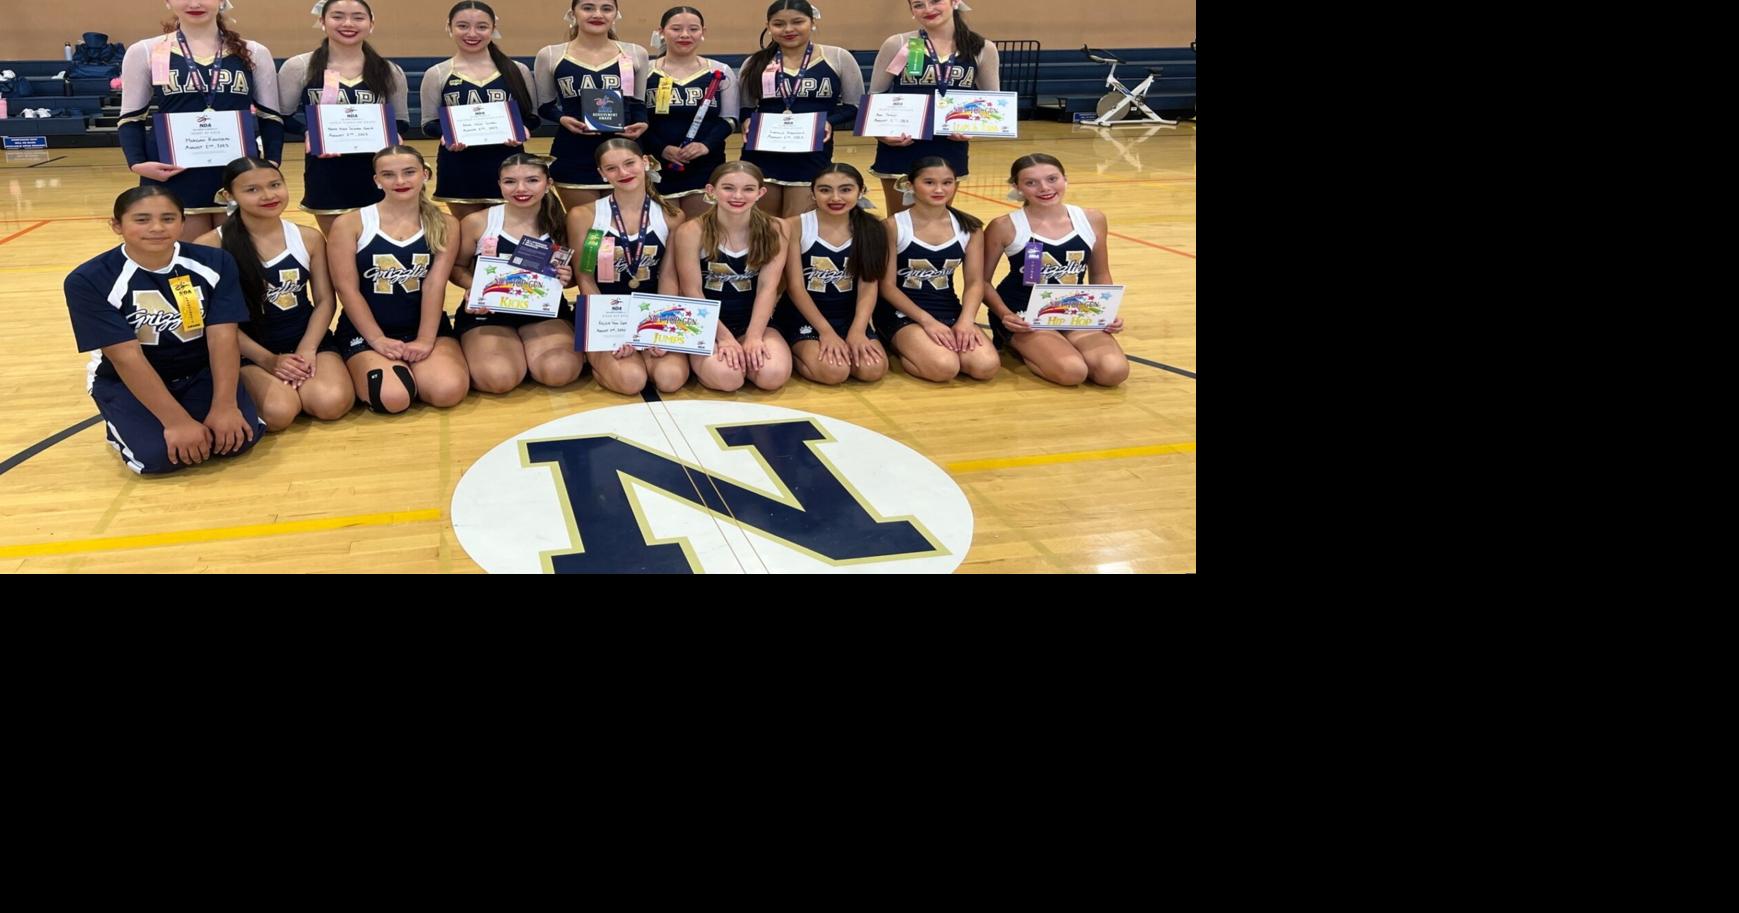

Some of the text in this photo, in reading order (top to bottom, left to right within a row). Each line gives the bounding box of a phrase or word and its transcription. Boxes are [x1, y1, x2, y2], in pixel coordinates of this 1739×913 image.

[558, 75, 621, 98] NAP
[373, 253, 430, 294] N
[517, 417, 953, 574] N
